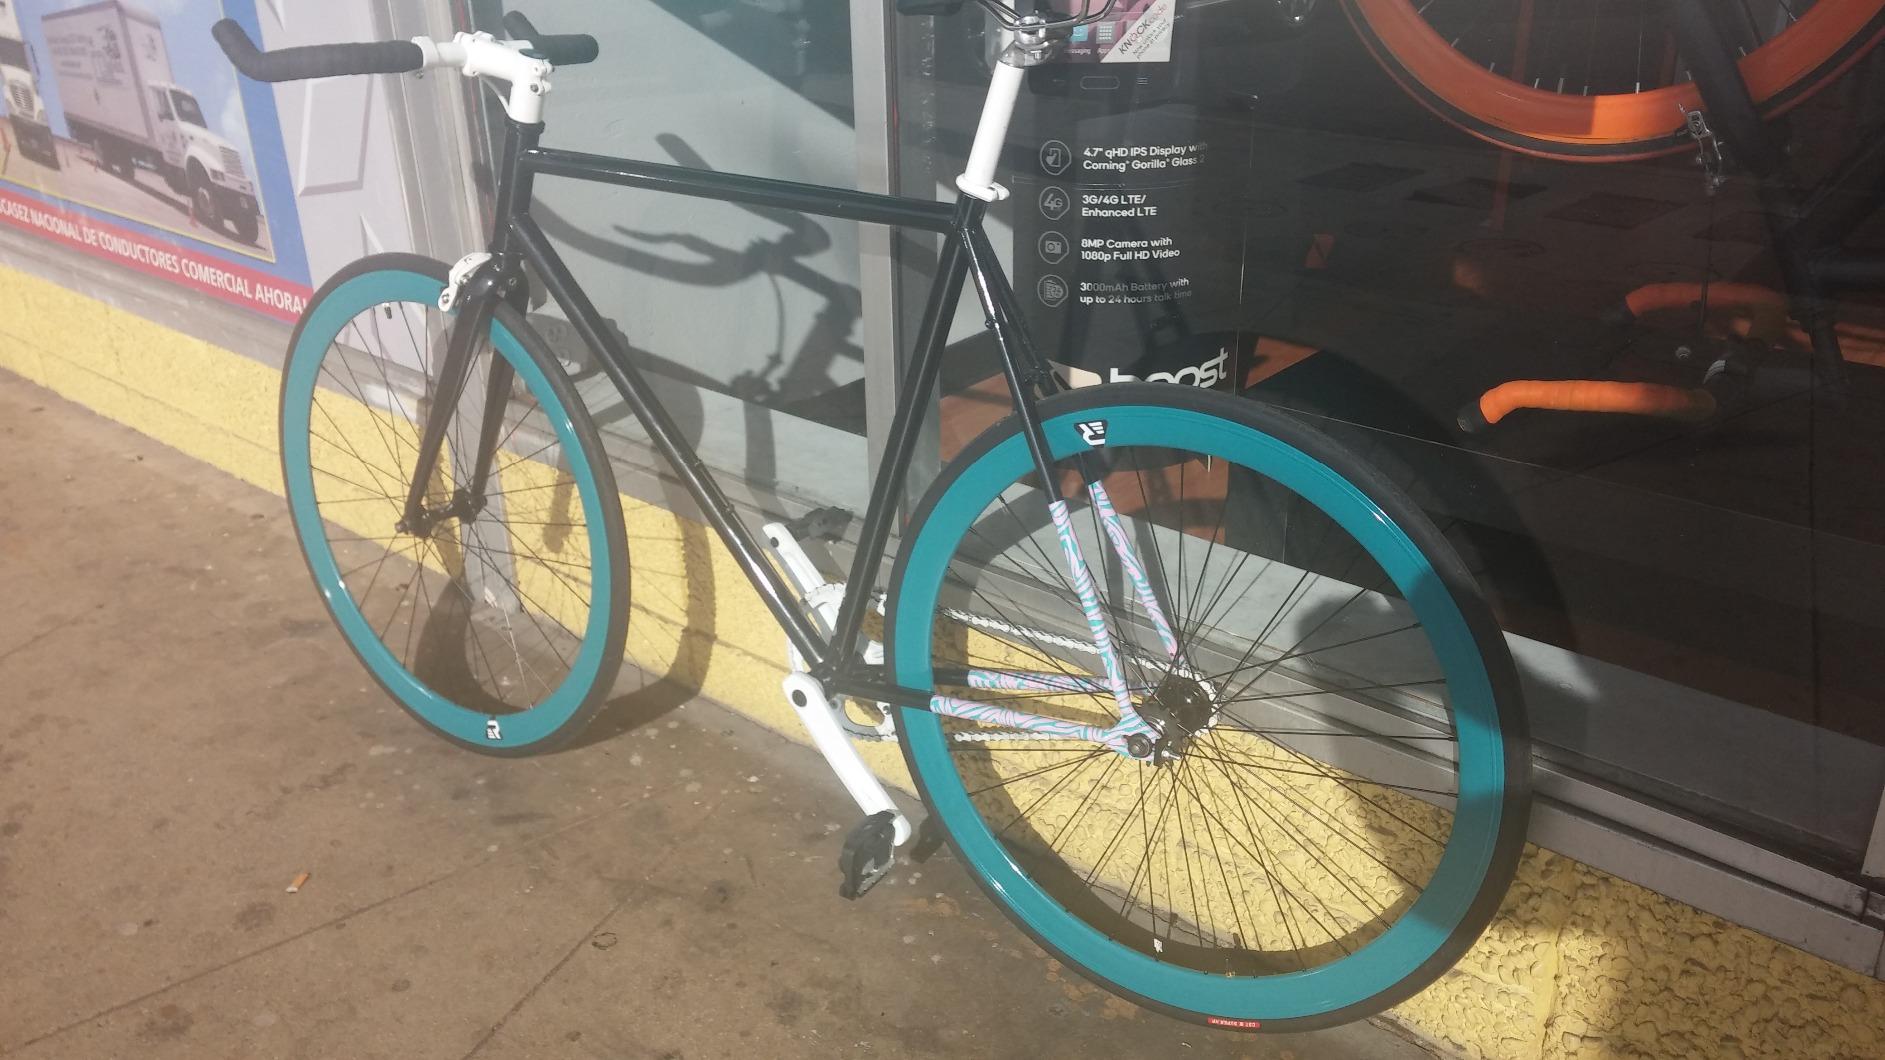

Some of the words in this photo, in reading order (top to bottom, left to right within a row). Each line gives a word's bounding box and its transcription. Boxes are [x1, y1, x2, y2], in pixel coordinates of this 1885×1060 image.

[1105, 148, 1128, 160] qHD
[1130, 147, 1147, 157] IPS
[1150, 145, 1187, 159] Display
[1189, 141, 1208, 152] with
[1172, 156, 1197, 168] Glass
[1082, 194, 1119, 205] 3G/4G
[1121, 194, 1146, 204] LTE/
[1082, 207, 1135, 217] Enhanced
[1137, 207, 1157, 216] LTE
[0, 198, 31, 224] CASEZ
[30, 208, 82, 241] NACIONAL
[82, 226, 97, 247] DE
[99, 231, 180, 274] CONDUCTORES
[181, 258, 252, 299] COMERCIAL
[1081, 239, 1104, 249] 8MP
[1106, 239, 1148, 249] Camera
[1150, 237, 1172, 247] with
[1081, 251, 1111, 262] 1080p
[1113, 250, 1132, 261] Full
[1134, 250, 1150, 260] HD
[1152, 248, 1180, 260] Video
[1080, 282, 1129, 292] 3000mAh
[1131, 281, 1167, 293] Battery
[1169, 278, 1189, 288] with
[1080, 295, 1093, 305] up
[1095, 294, 1106, 304] to
[1108, 294, 1121, 304] 24
[1123, 292, 1152, 304] hours
[1153, 292, 1172, 302] talk
[1174, 289, 1192, 299] time
